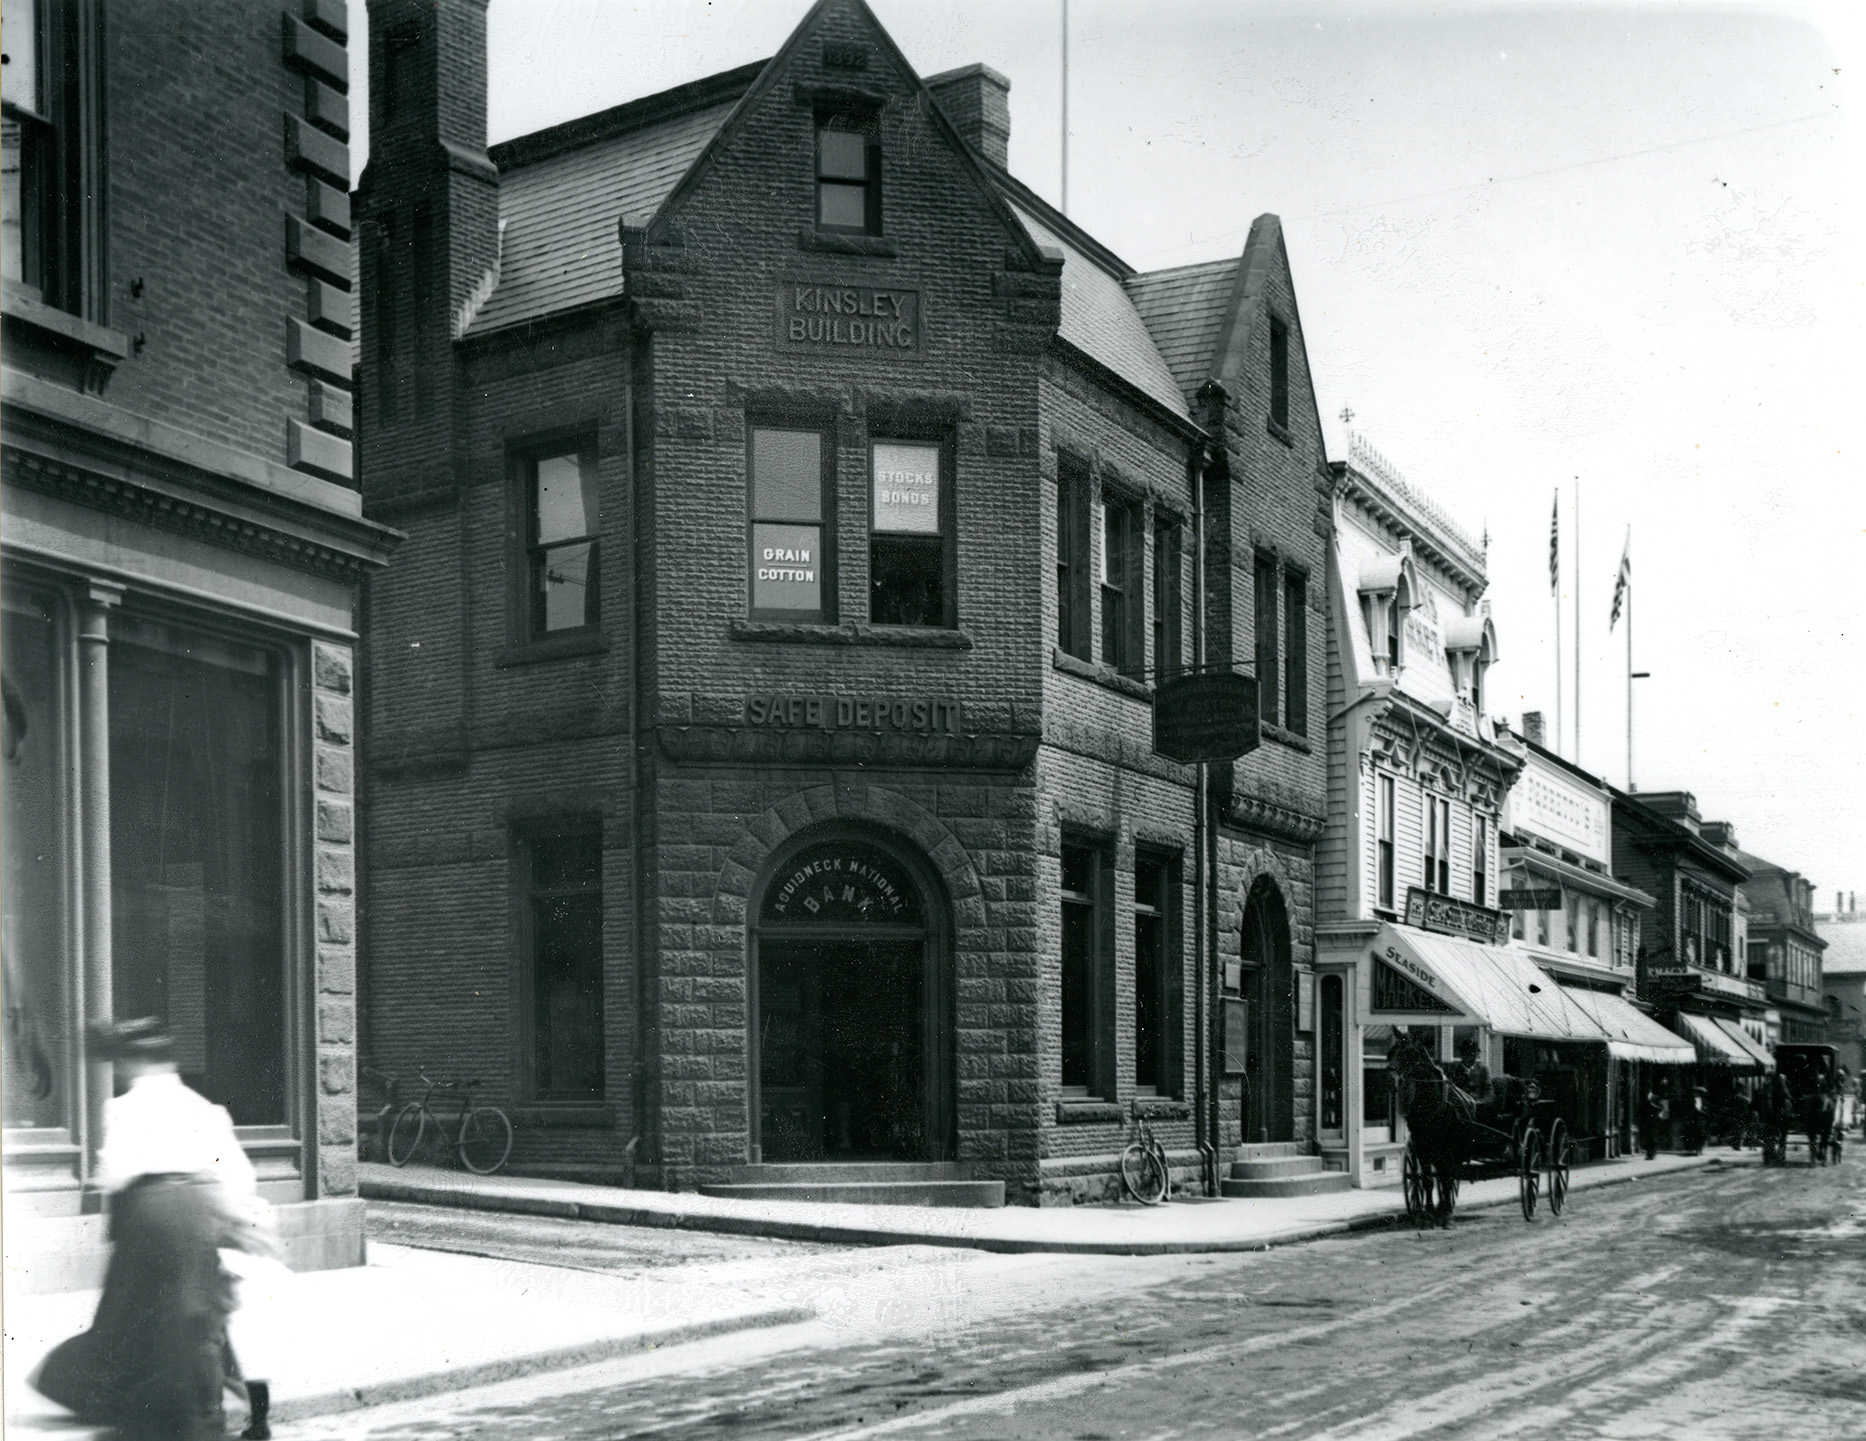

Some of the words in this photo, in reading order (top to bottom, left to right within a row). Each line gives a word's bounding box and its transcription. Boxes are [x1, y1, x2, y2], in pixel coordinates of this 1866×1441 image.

[795, 287, 906, 317] KINSLEY
[789, 318, 911, 347] BUILDING
[877, 471, 934, 485] STOCKS
[881, 491, 930, 505] BONDS
[763, 548, 811, 563] GRAIN
[758, 568, 815, 583] COTTON
[749, 697, 823, 726] SAFE
[837, 699, 956, 732] DEPOSIT
[774, 858, 842, 913] AQUIDNECK
[849, 860, 904, 914] NATIONAL
[803, 884, 874, 914] BANK
[1385, 946, 1436, 988] SEASIDE
